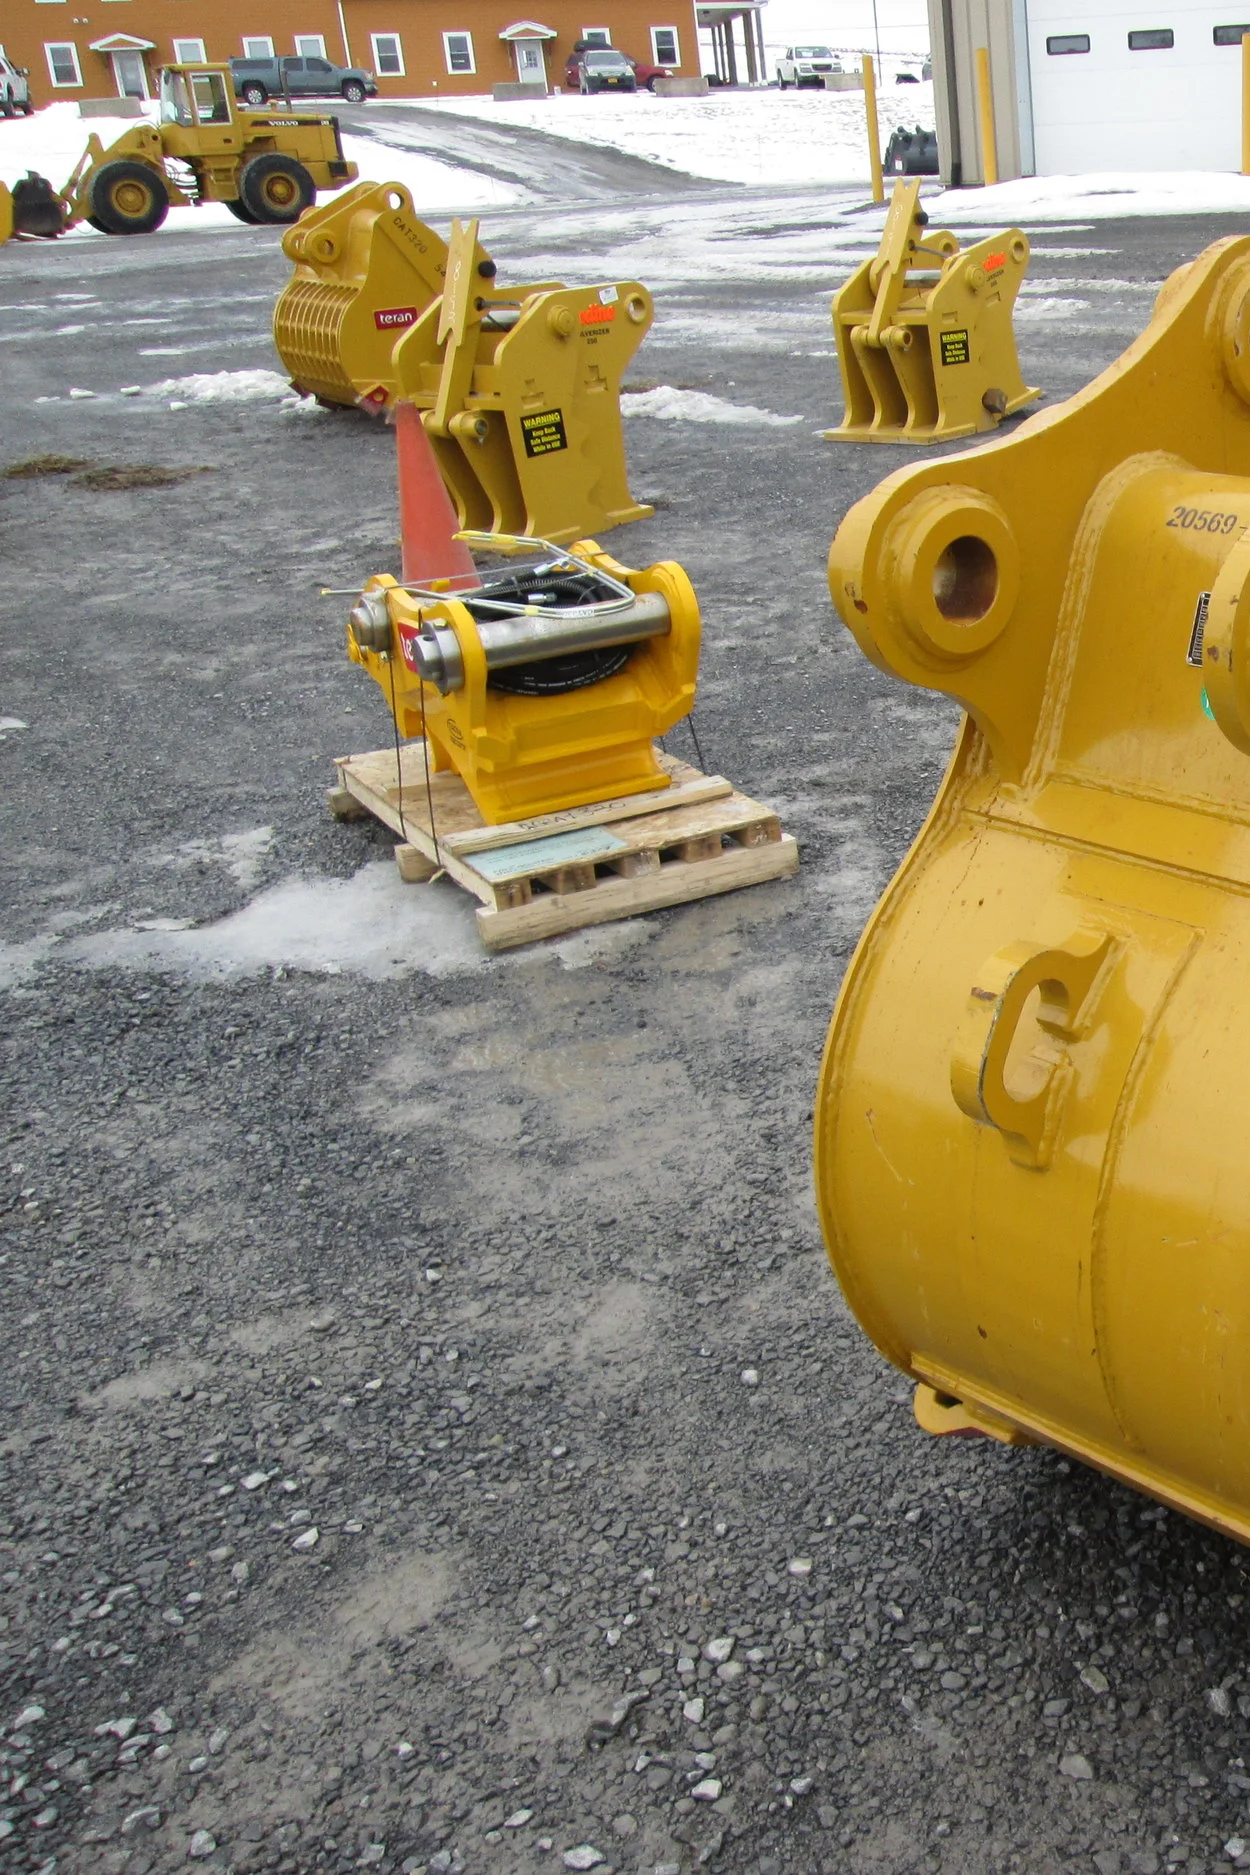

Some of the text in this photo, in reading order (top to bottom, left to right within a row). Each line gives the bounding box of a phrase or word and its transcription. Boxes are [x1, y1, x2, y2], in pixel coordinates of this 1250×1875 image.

[393, 217, 428, 254] CAT320
[379, 312, 413, 324] teran
[523, 412, 561, 428] WARNING
